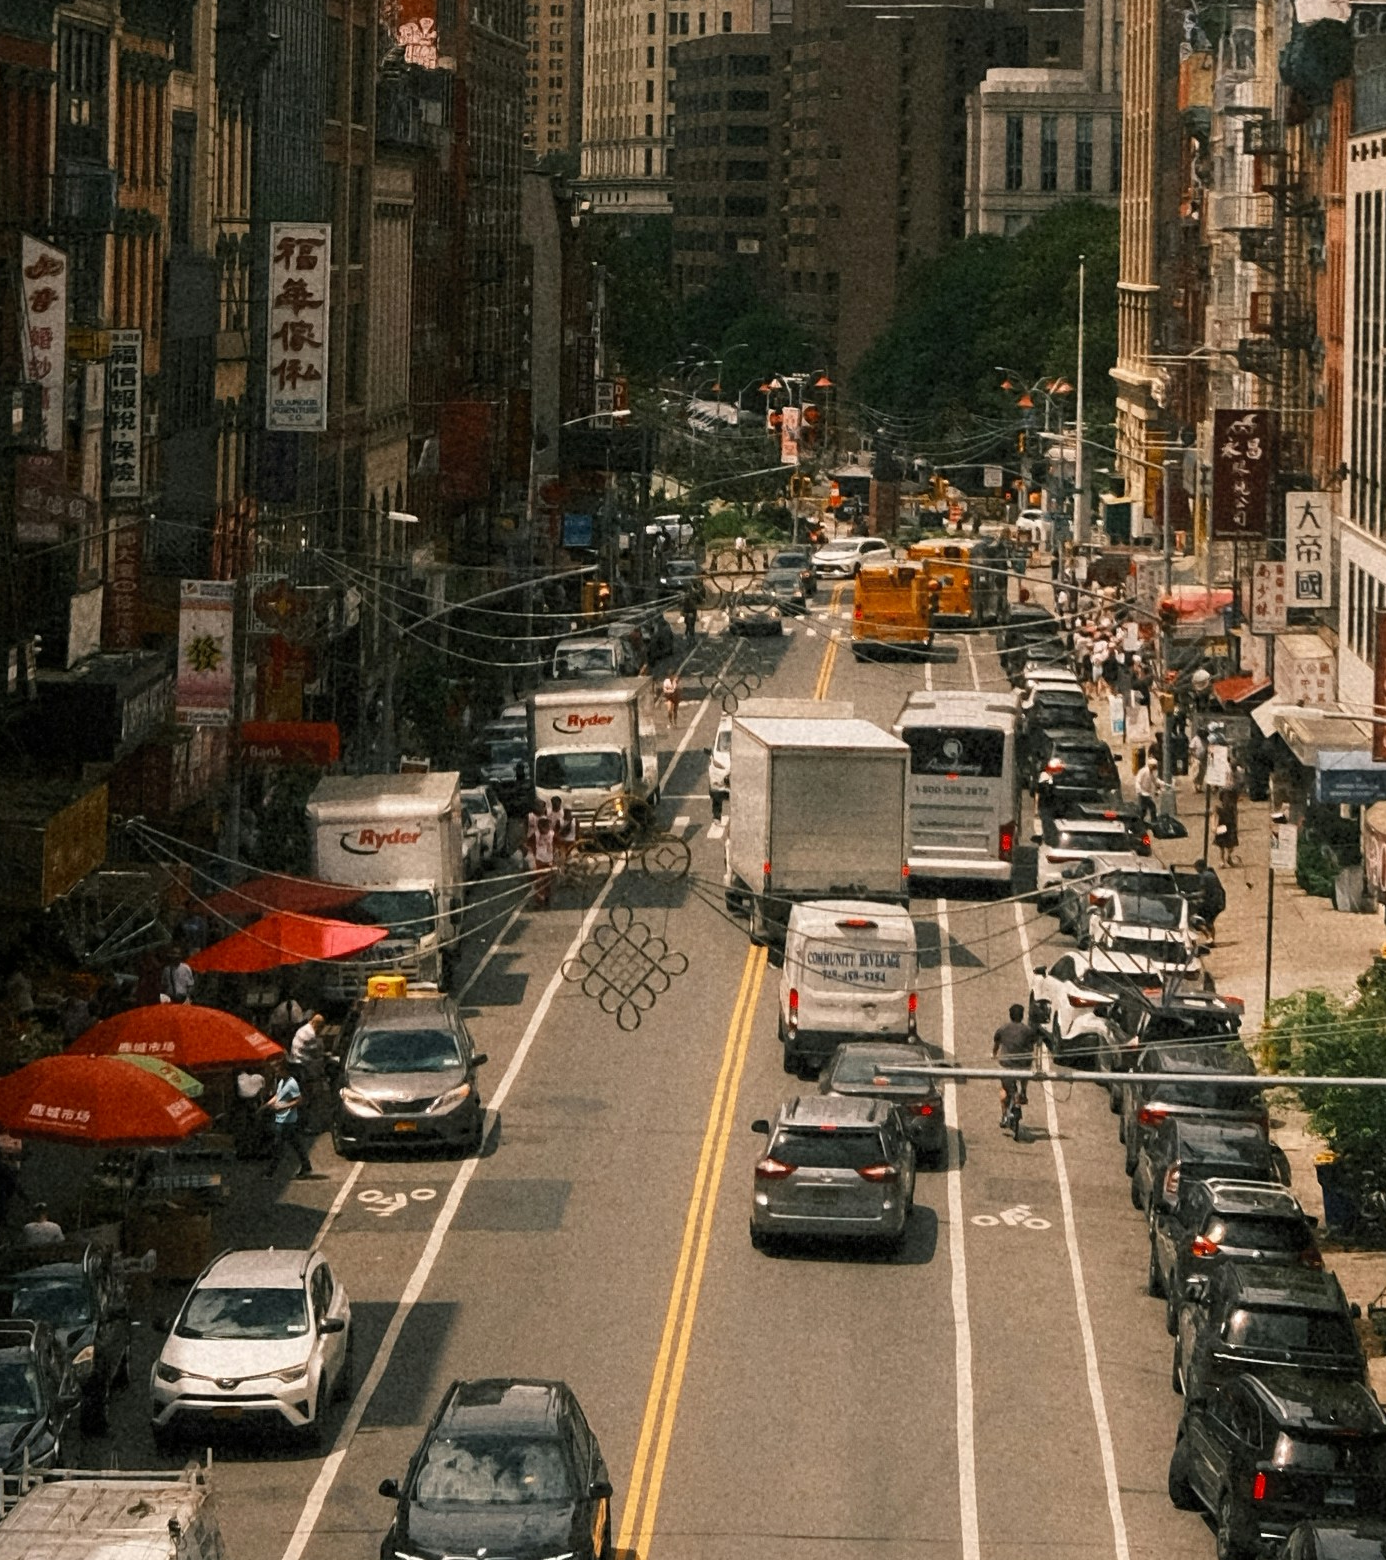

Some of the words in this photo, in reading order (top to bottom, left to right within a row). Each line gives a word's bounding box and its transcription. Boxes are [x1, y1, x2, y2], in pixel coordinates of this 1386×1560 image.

[1294, 499, 1323, 600] 大帝國
[566, 711, 615, 729] Ryder
[359, 827, 422, 849] Ryder
[807, 950, 855, 967] COMMUNITY
